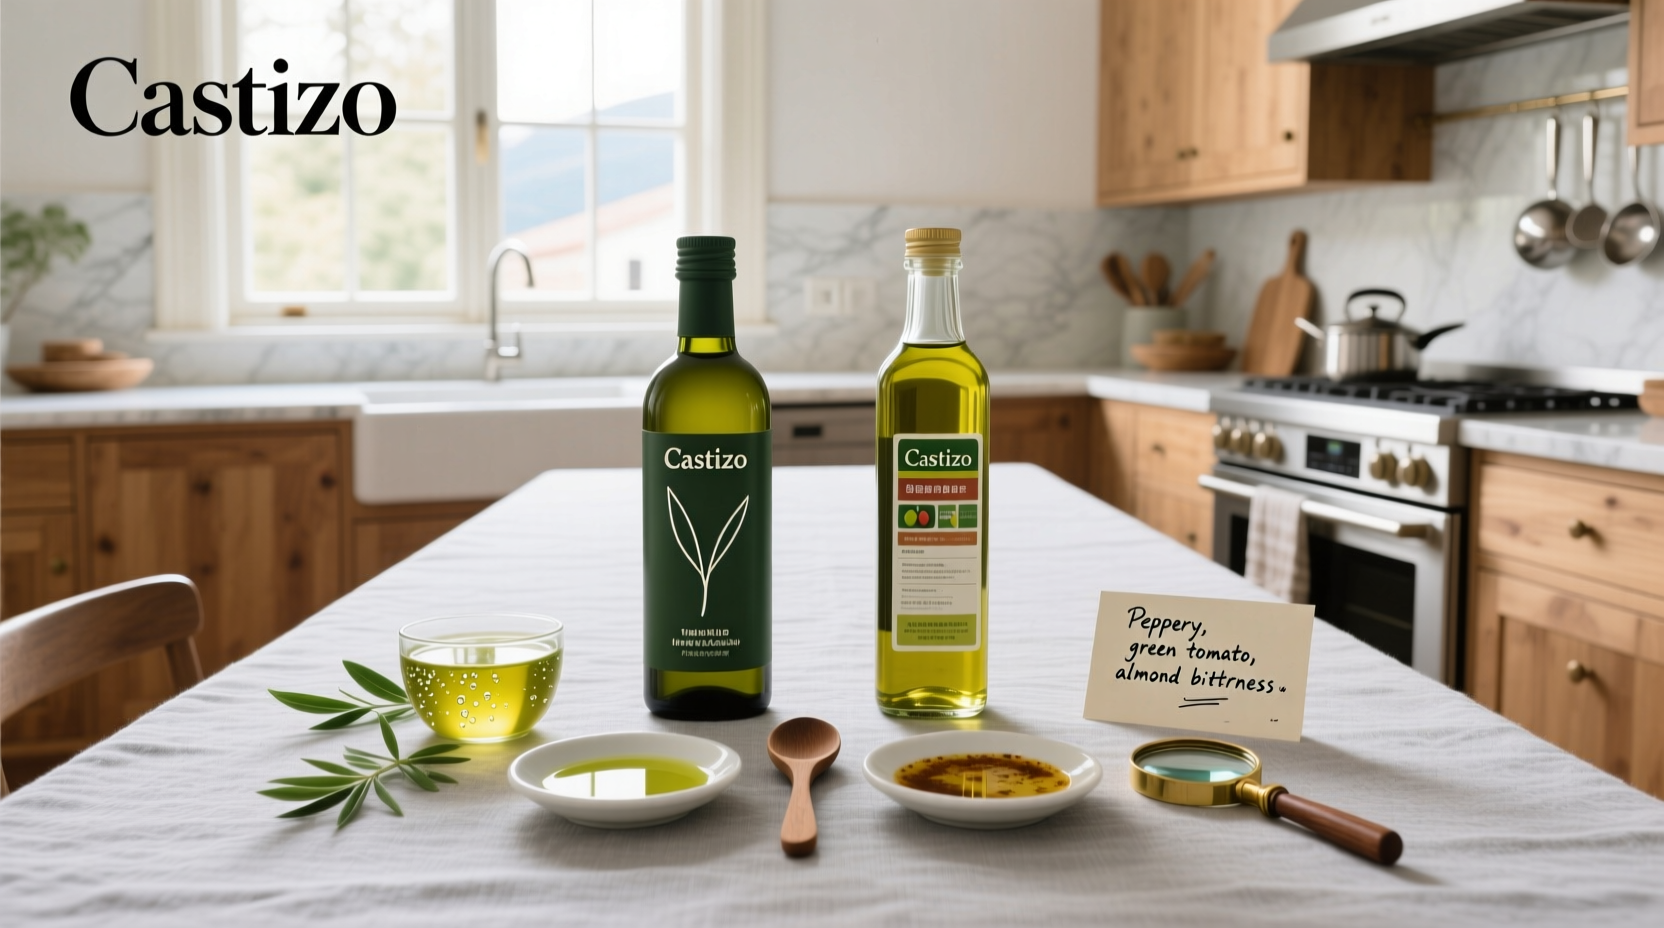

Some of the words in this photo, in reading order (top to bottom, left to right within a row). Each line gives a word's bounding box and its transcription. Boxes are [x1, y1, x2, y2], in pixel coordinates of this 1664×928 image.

[664, 447, 748, 470] Castizo
[904, 448, 972, 467] Castizo
[1127, 606, 1207, 642] Peppery,
[1124, 641, 1176, 662] green
[1186, 642, 1256, 667] tomato,
[1115, 662, 1182, 685] almond
